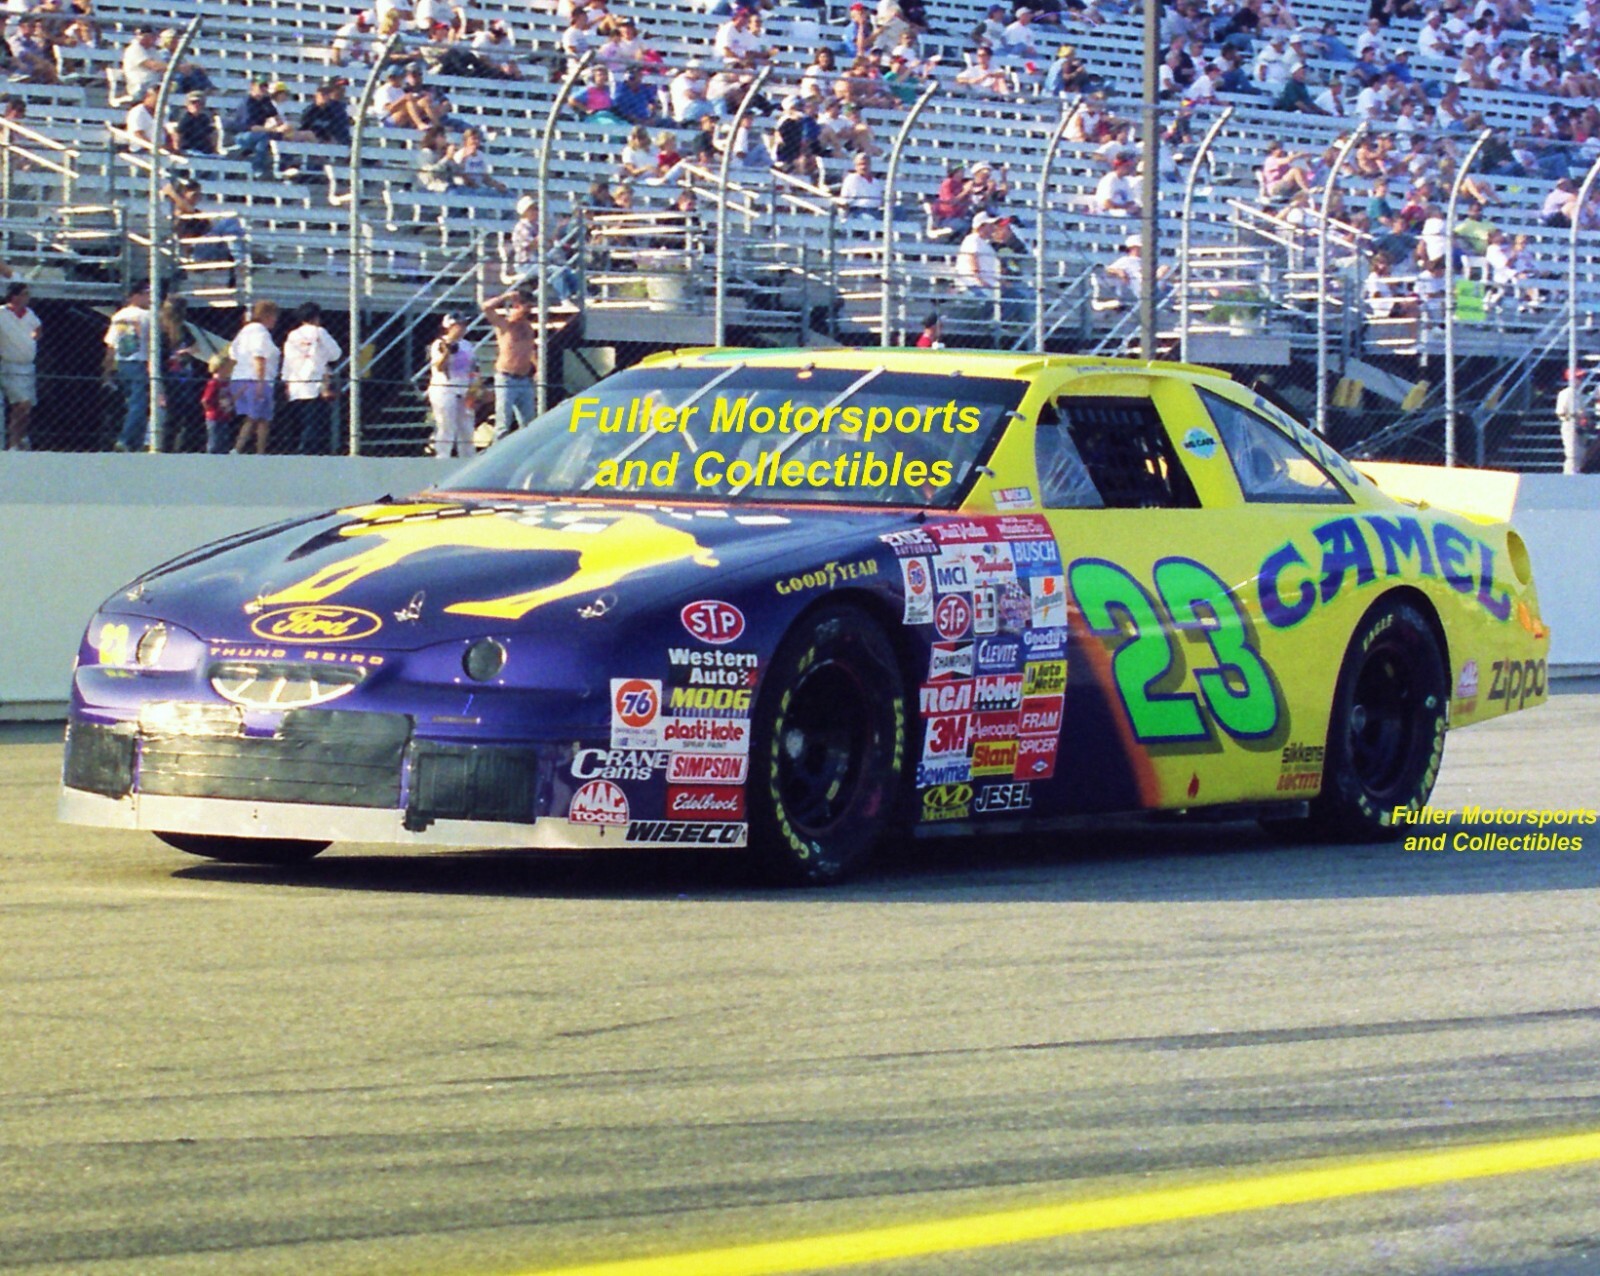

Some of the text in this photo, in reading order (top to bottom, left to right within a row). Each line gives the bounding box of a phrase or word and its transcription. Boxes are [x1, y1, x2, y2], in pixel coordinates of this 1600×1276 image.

[1015, 541, 1057, 561] BUSCH
[775, 559, 878, 595] GOODYEAR
[937, 566, 967, 586] MCI
[1257, 515, 1511, 629] CAMEL
[272, 610, 358, 636] Ford
[690, 604, 736, 635] STP
[940, 600, 966, 631] STP
[978, 639, 1018, 664] CLEVITE
[1024, 629, 1068, 651] Goody's
[1067, 556, 1281, 742] 23
[668, 647, 758, 668] Western
[934, 654, 972, 669] CHAMPION
[689, 667, 739, 686] Auto
[1038, 664, 1061, 677] Auto
[621, 689, 653, 717] 76
[670, 687, 752, 710] MOOG
[919, 684, 973, 713] RCA
[974, 676, 1022, 709] Holley
[664, 719, 744, 742] plasti-kote
[969, 715, 1018, 738] Aeroquip
[1021, 711, 1059, 728] FRAM
[929, 717, 968, 753] 3M
[1019, 738, 1057, 754] SPICER
[673, 756, 743, 778] SIMPSON
[972, 743, 1017, 768] Stant
[573, 783, 626, 812] MAC
[672, 791, 739, 811] Edelbrock
[975, 782, 1032, 813] JESEL
[573, 811, 625, 823] TOOLS
[625, 822, 744, 844] WISECO
